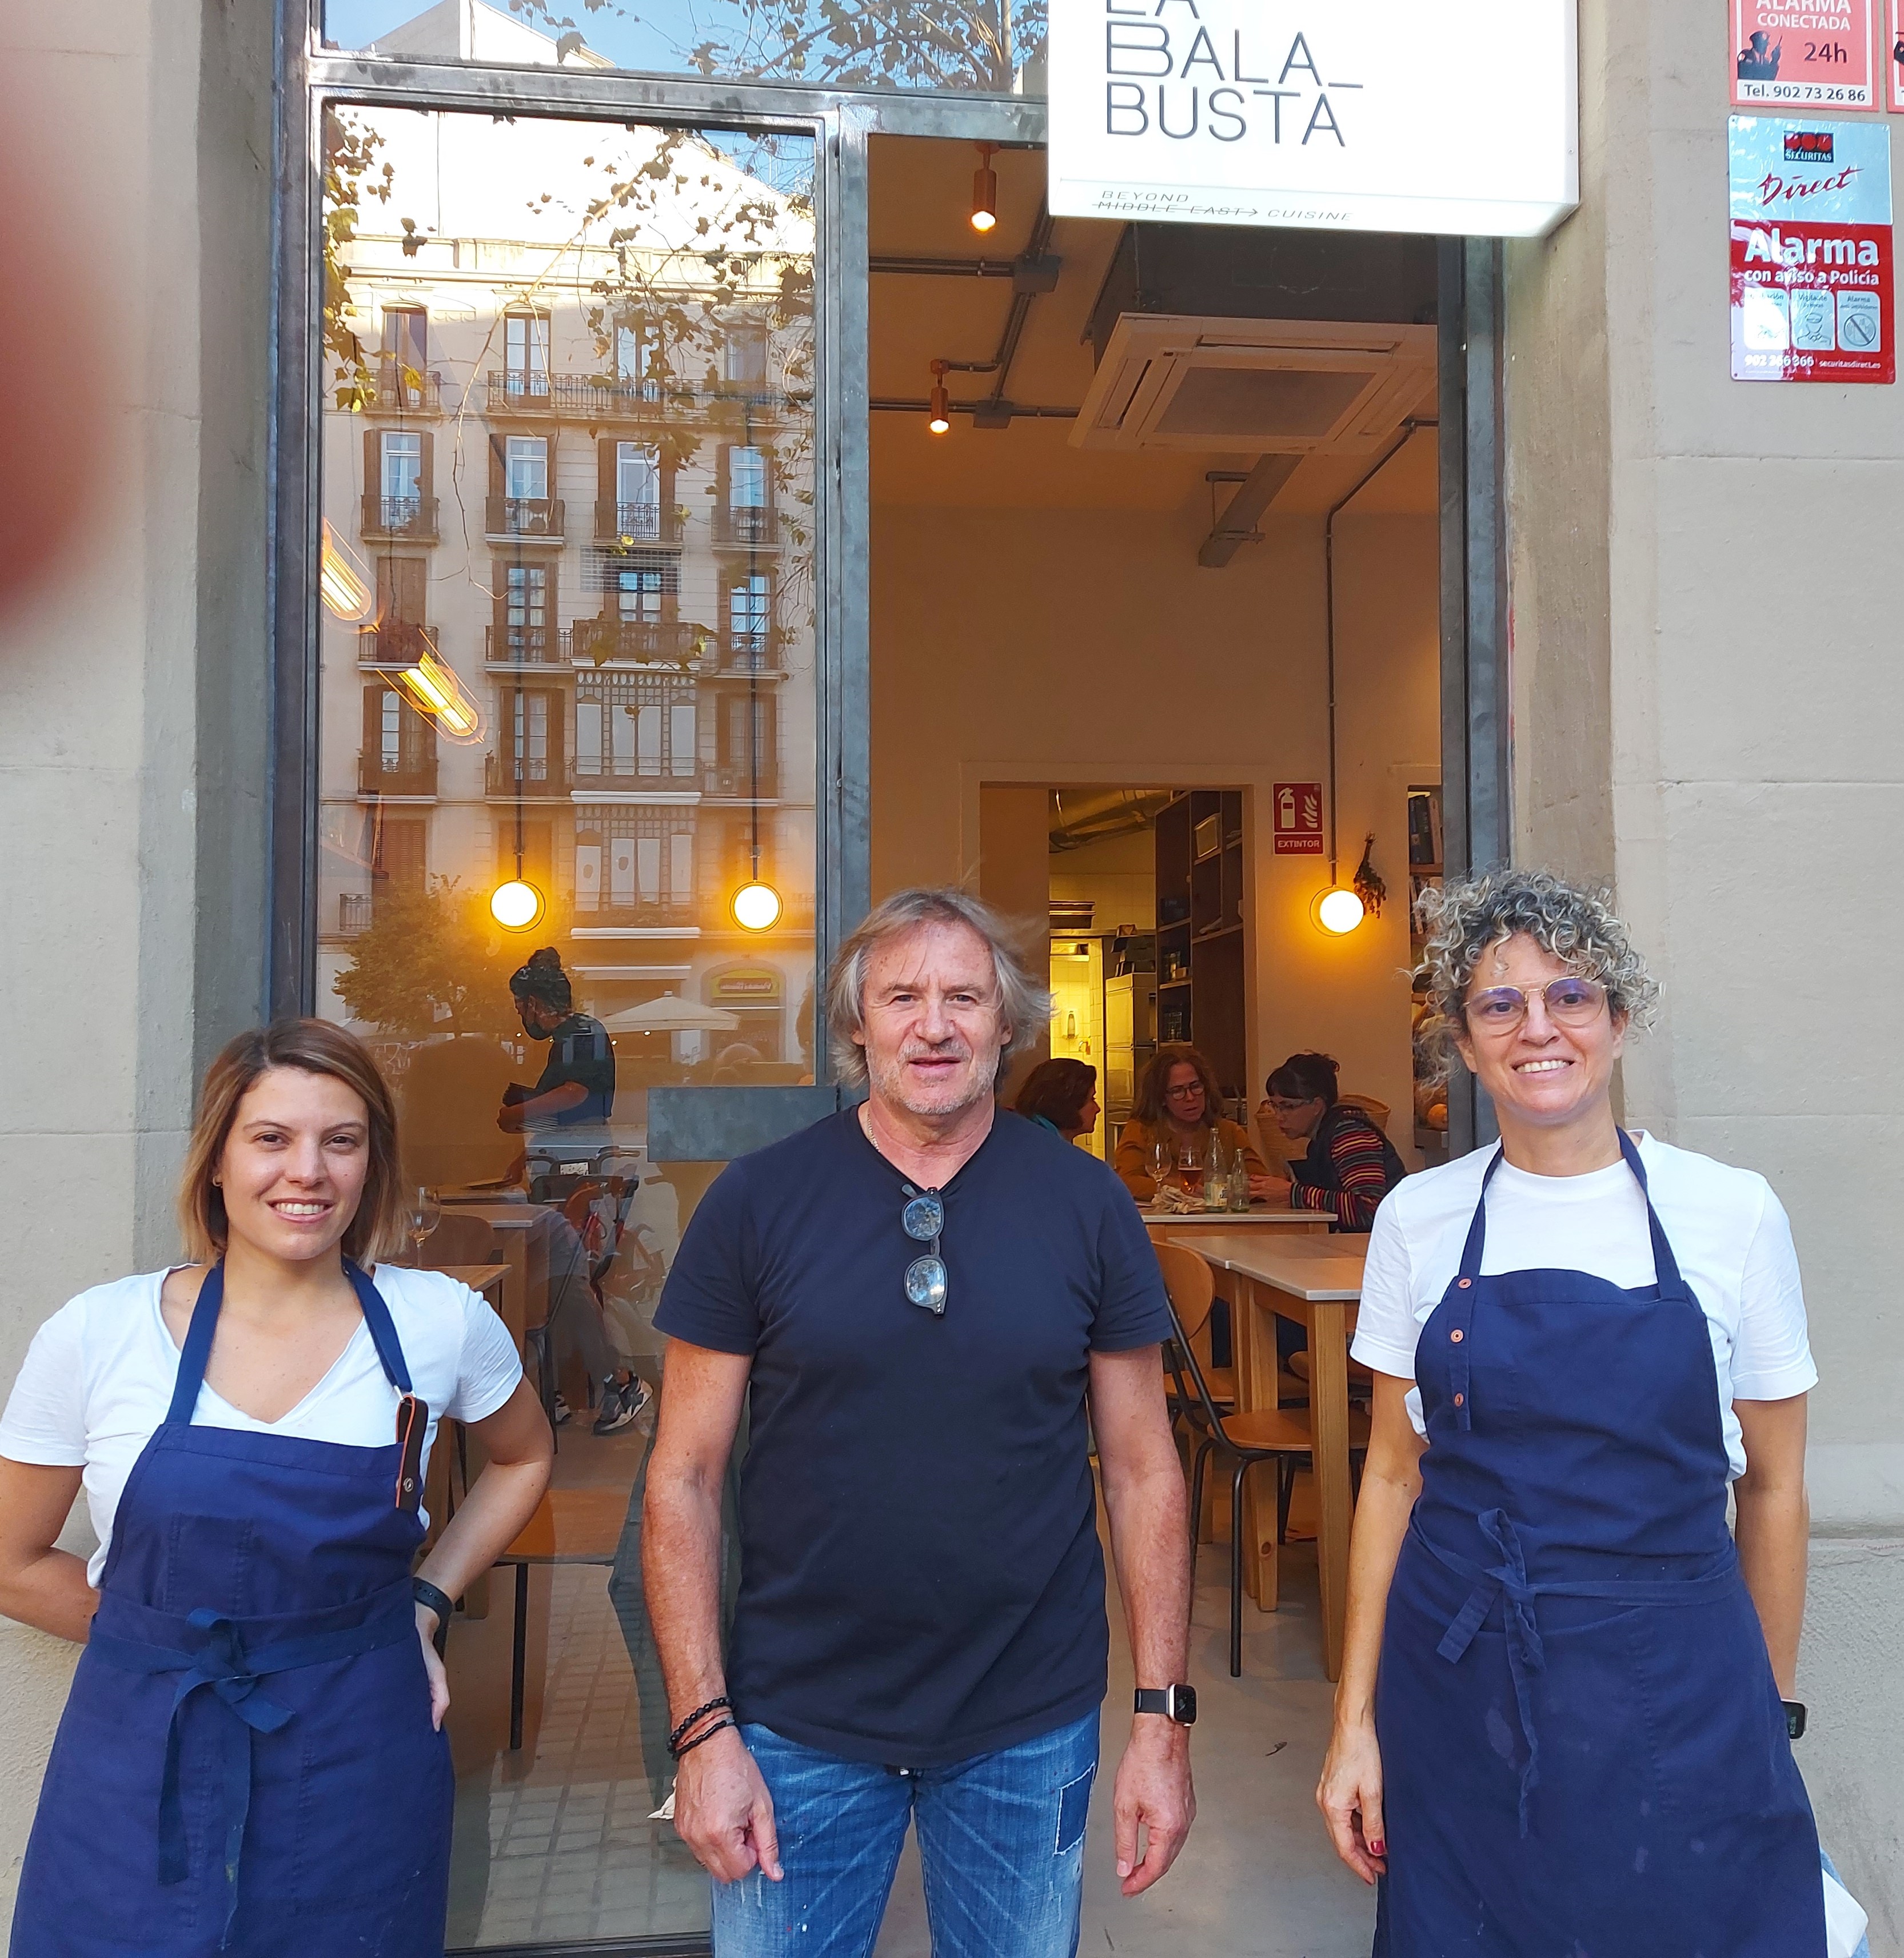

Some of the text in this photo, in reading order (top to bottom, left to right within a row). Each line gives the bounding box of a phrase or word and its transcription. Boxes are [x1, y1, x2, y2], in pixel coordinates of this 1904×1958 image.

[1757, 13, 1851, 30] CONECTADA
[1803, 42, 1847, 64] 24h
[1745, 85, 1865, 101] Tel. 902 73 26 86
[1107, 81, 1346, 147] BUSTA
[1785, 147, 1832, 161] SECURITAS
[1757, 165, 1865, 206] Direct
[1102, 190, 1189, 202] BEYOND
[1097, 201, 1354, 221] MIDDLE EAST CUISINE
[1745, 228, 1879, 266] Alarma
[1745, 269, 1879, 285] con aviso a Policía
[1278, 840, 1320, 848] EXTINTOR
